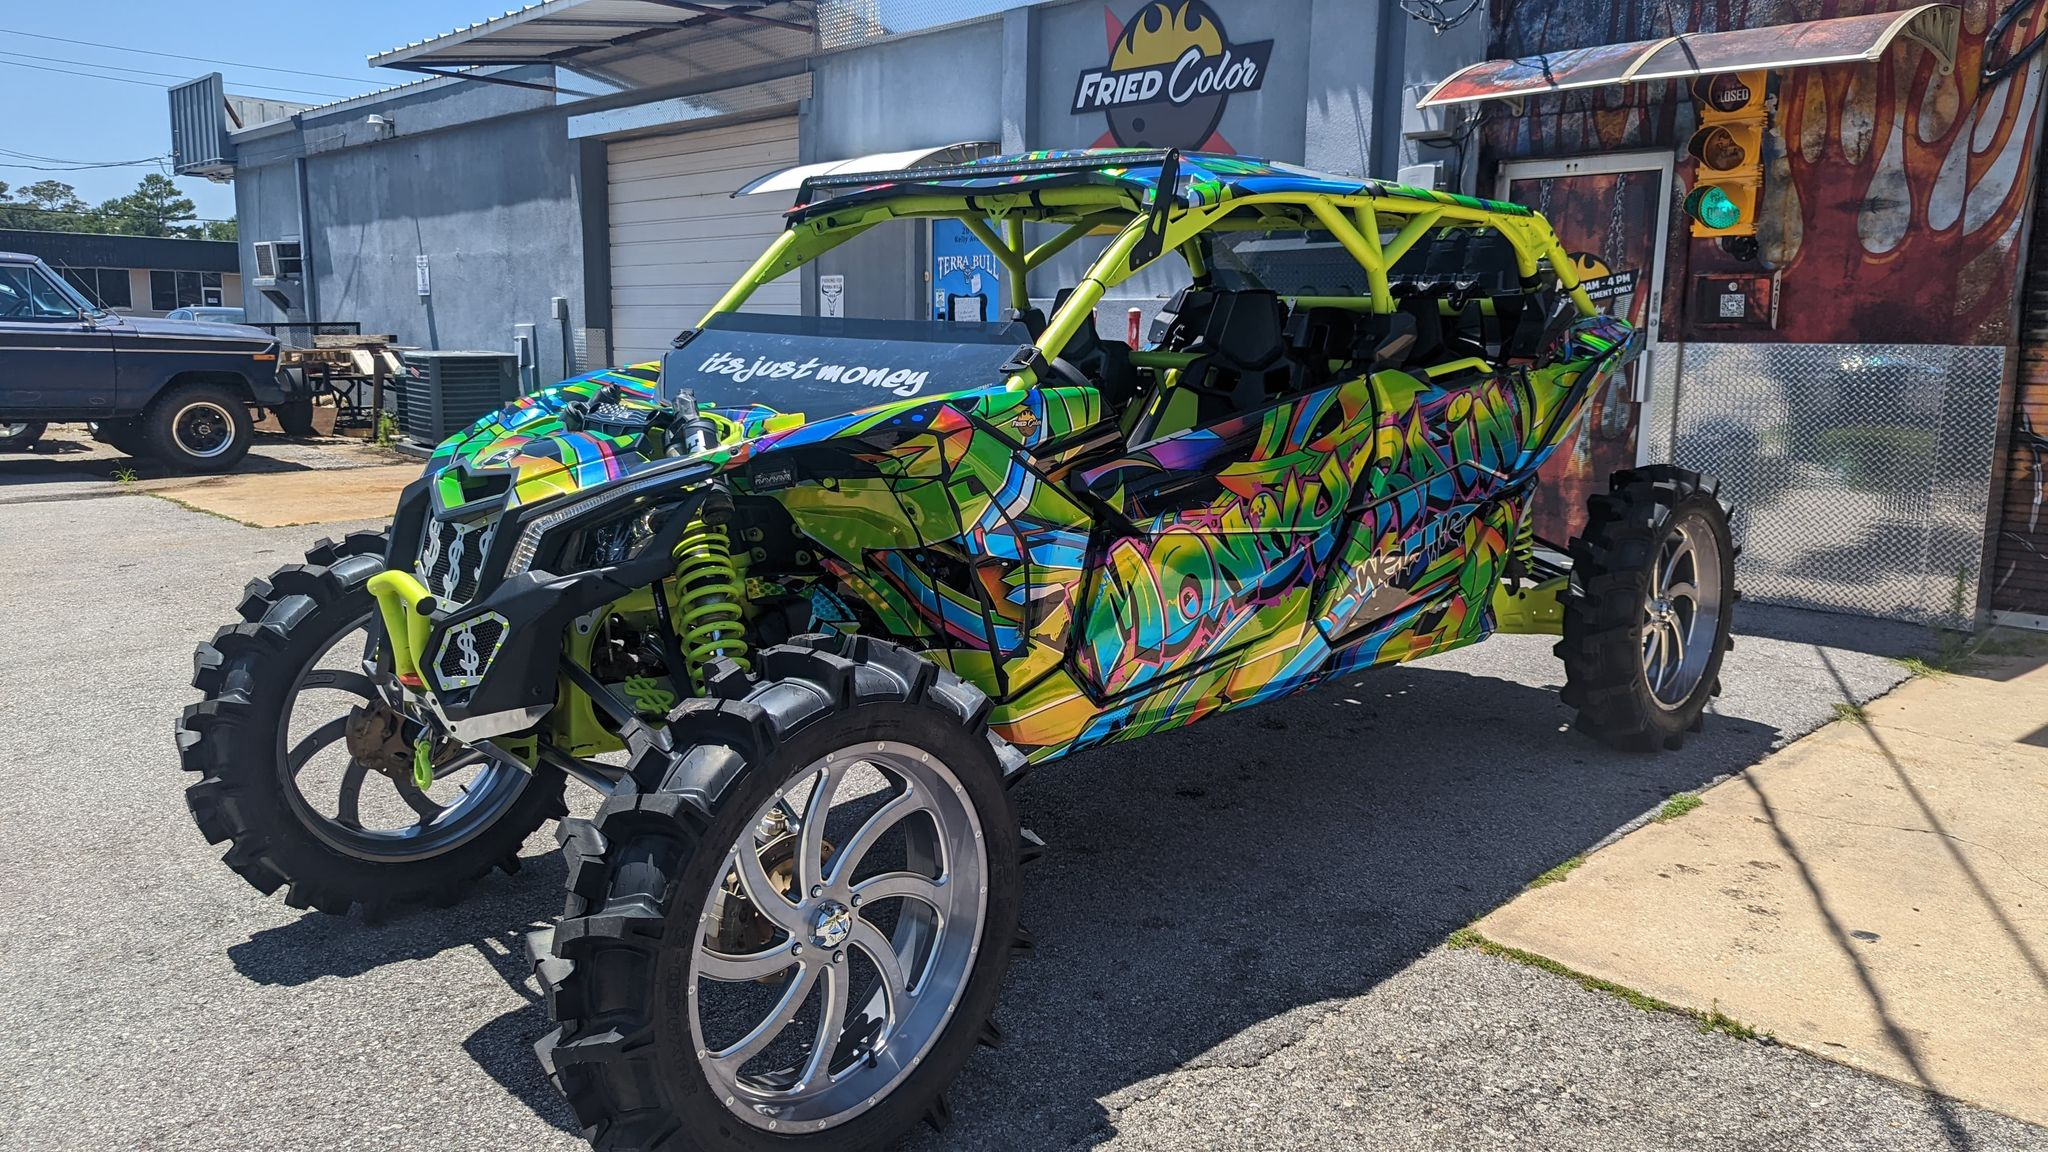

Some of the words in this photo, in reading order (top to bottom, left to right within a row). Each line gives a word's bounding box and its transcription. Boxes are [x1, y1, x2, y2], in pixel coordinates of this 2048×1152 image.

[1168, 48, 1259, 103] Color
[937, 256, 969, 280] TERRA
[972, 254, 999, 281] BULL
[1616, 273, 1631, 284] PM
[1613, 284, 1633, 294] ONLY
[816, 364, 930, 397] money
